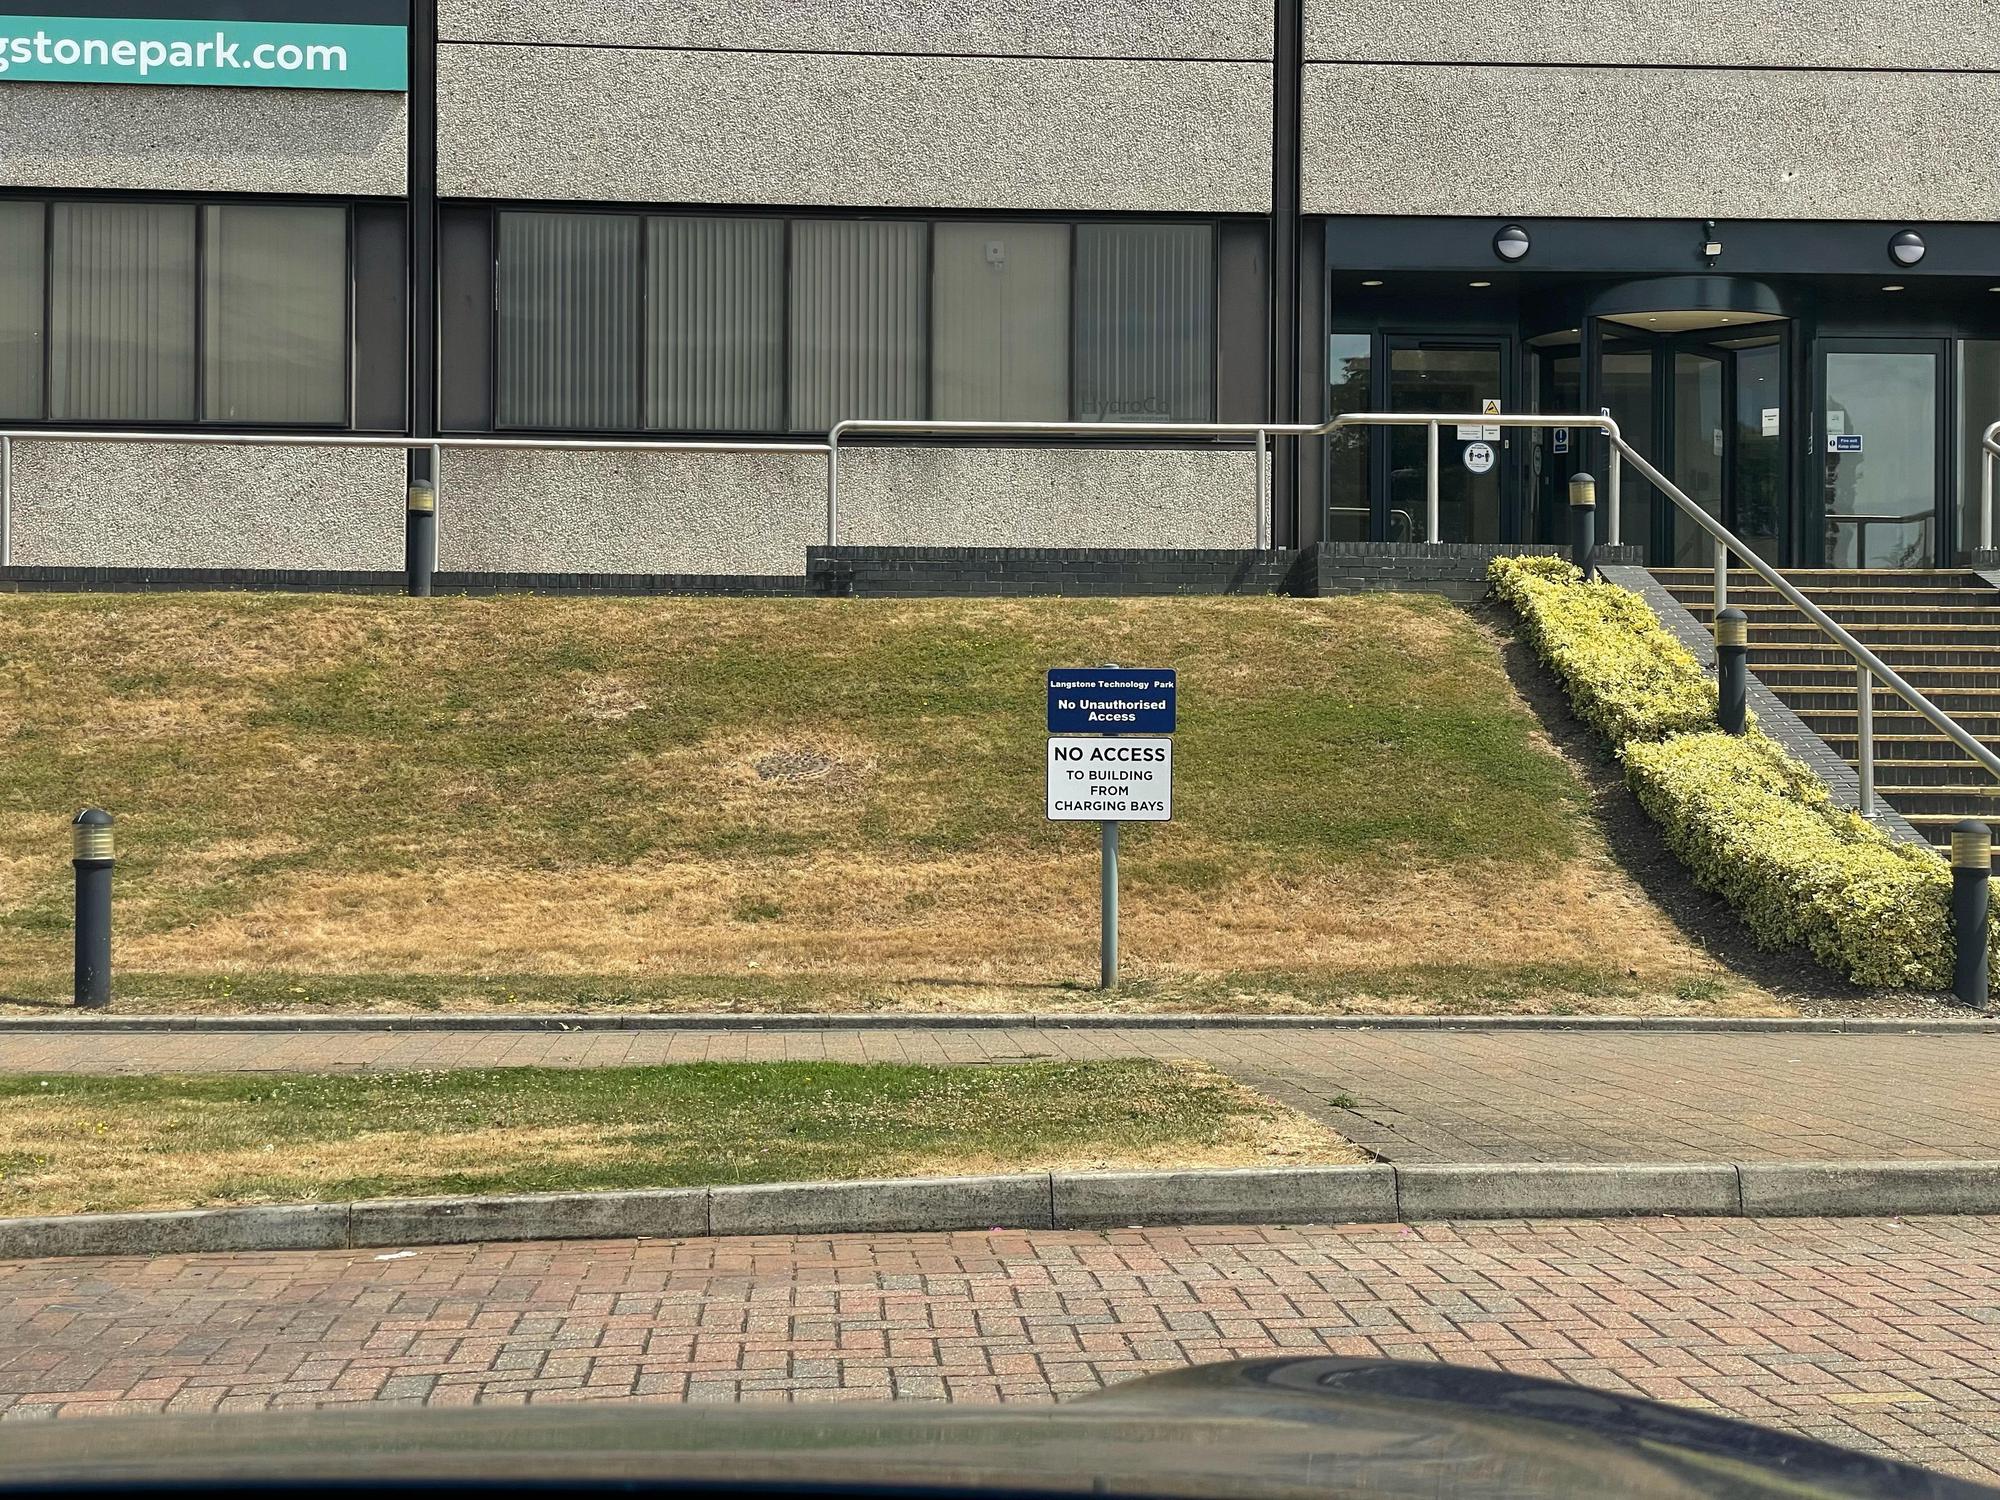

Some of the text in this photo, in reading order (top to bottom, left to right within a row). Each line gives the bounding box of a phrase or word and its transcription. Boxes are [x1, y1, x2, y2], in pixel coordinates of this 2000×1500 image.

[1050, 680, 1096, 689] Langstone
[1098, 680, 1149, 689] Technology
[1058, 699, 1166, 710] No Unauthorised
[1088, 711, 1136, 721] Access
[1054, 747, 1165, 762] NO ACCESS
[1066, 770, 1153, 781] TO BUILDING
[1090, 785, 1129, 796] FROM
[1054, 801, 1164, 811] CHARGING BAYS
